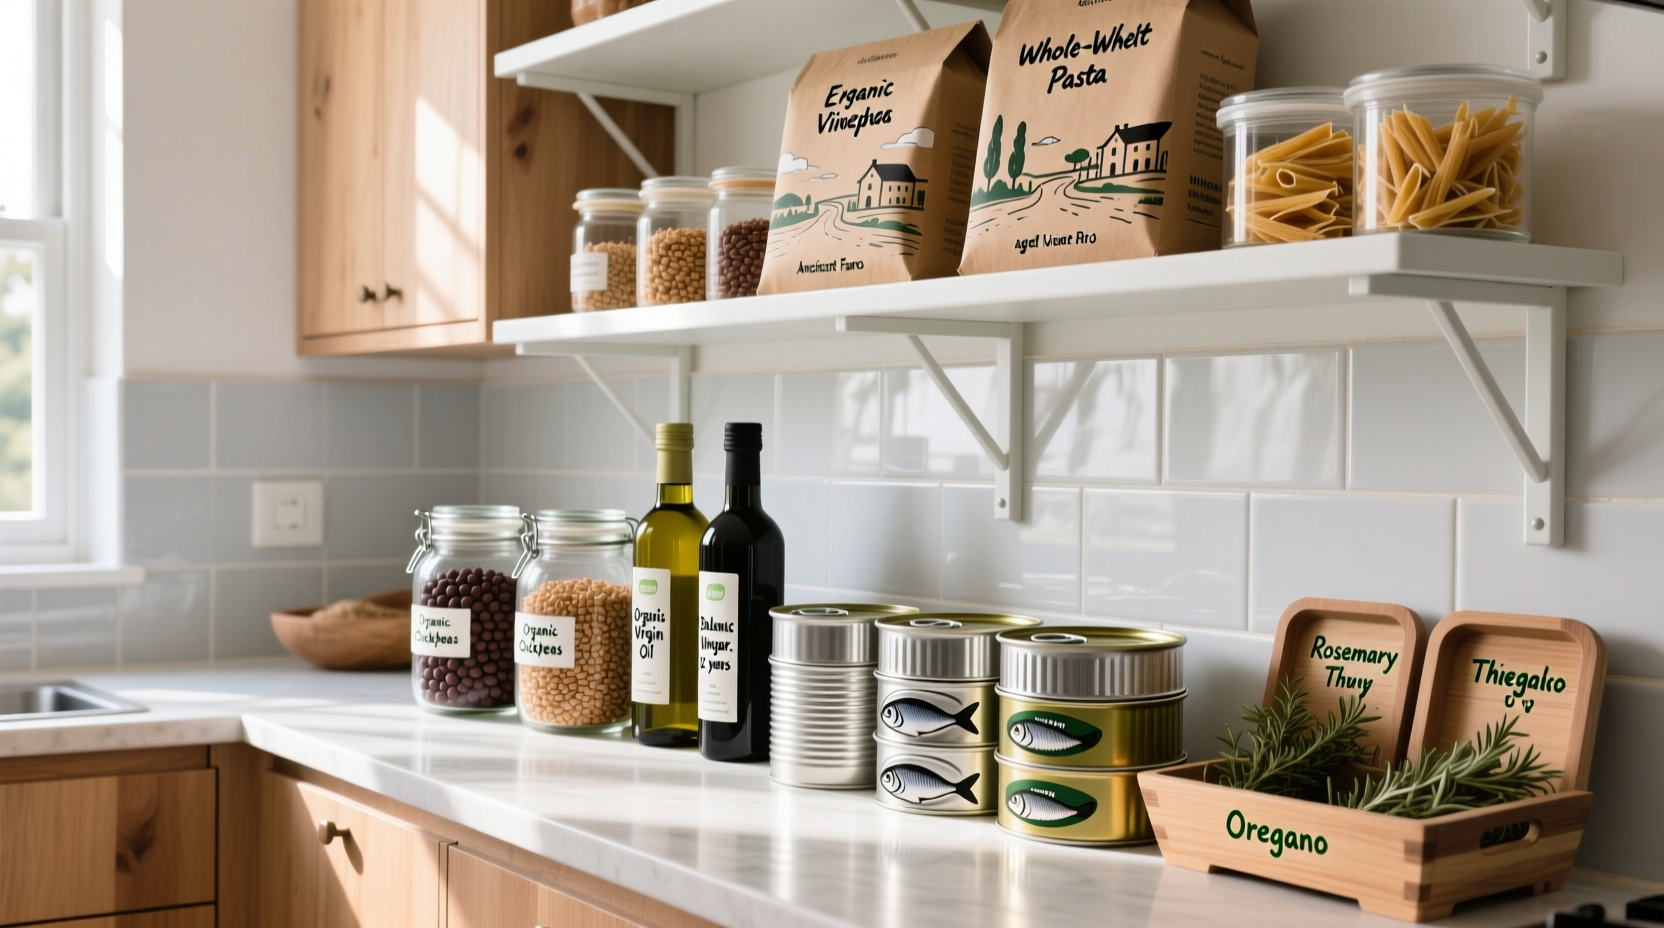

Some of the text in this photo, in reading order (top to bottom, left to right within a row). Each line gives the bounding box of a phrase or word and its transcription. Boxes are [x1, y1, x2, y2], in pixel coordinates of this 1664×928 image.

[1046, 64, 1107, 94] Pasta
[639, 644, 654, 660] Oil
[1310, 635, 1399, 674] Rosemary
[1226, 809, 1329, 858] Oregano
